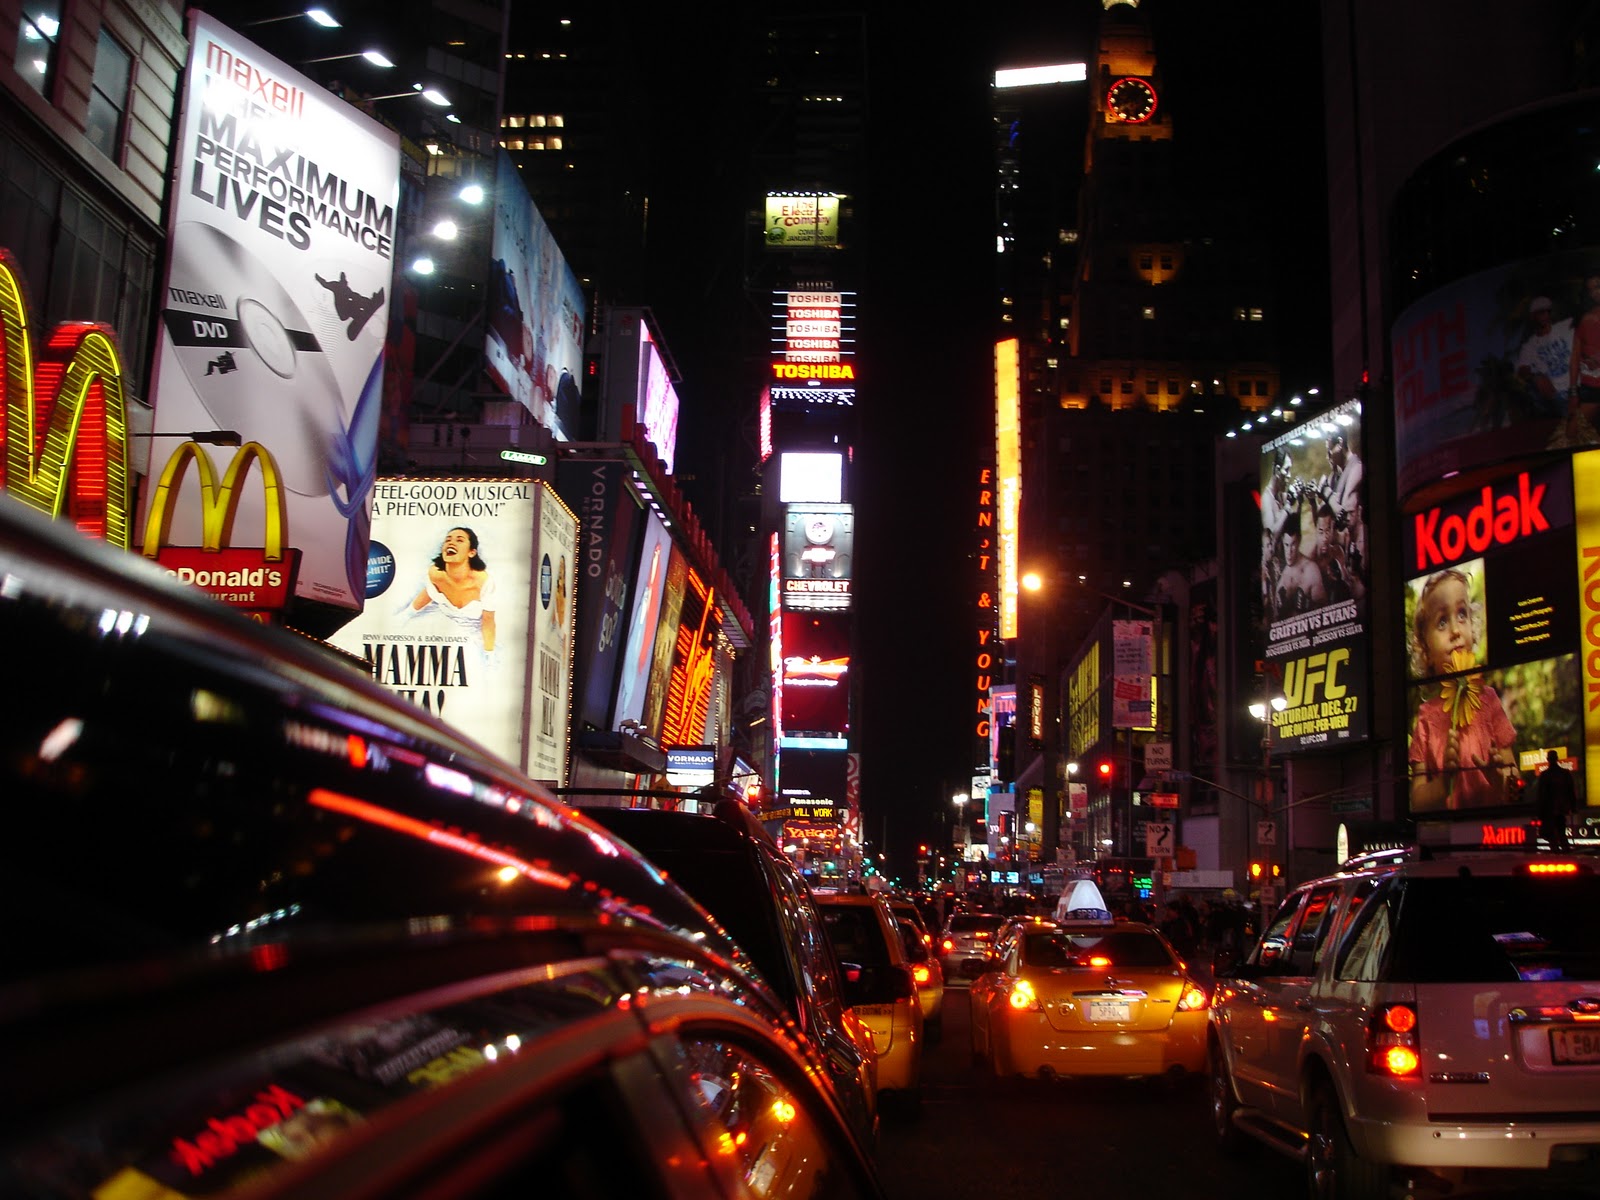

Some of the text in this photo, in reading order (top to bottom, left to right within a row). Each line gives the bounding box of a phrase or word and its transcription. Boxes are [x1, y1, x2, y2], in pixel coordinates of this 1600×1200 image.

[206, 40, 304, 120] maxell
[201, 101, 392, 236] MAXIMUM
[194, 133, 391, 260] PERFORMANCE
[191, 160, 312, 252] LIVES
[169, 286, 227, 311] maxell
[790, 295, 840, 304] TOSHIBA
[788, 309, 840, 319] TOSHIBA
[193, 320, 229, 340] DVD
[789, 324, 839, 333] TOSHIBA
[788, 339, 840, 349] TOSHIBA
[787, 354, 839, 362] TOSHIBA
[773, 364, 854, 379] TOSHIBA
[373, 485, 531, 500] FEEL-GOOD MUSICAL
[588, 466, 606, 578] VORNADO
[1415, 472, 1551, 571] Kodak
[163, 567, 282, 587] Donald's
[786, 580, 850, 592] CHEVROLET
[977, 593, 991, 608] &
[1269, 619, 1309, 642] GRIFFIN
[1309, 614, 1322, 630] VS
[1322, 604, 1358, 626] EVANS
[383, 634, 416, 642] ANDERSSON
[362, 643, 469, 687] MAMMA
[977, 630, 991, 738] YOUNG
[1283, 647, 1350, 709] UFC
[1272, 696, 1358, 727] SATURDAY, DEC. 27
[1152, 747, 1165, 755] NO
[667, 755, 714, 763] VORNADO
[1146, 758, 1170, 766] TURNS
[790, 797, 833, 806] Panasonic
[793, 808, 810, 818] WILL
[813, 808, 833, 818] WORK
[1149, 825, 1161, 833] NO
